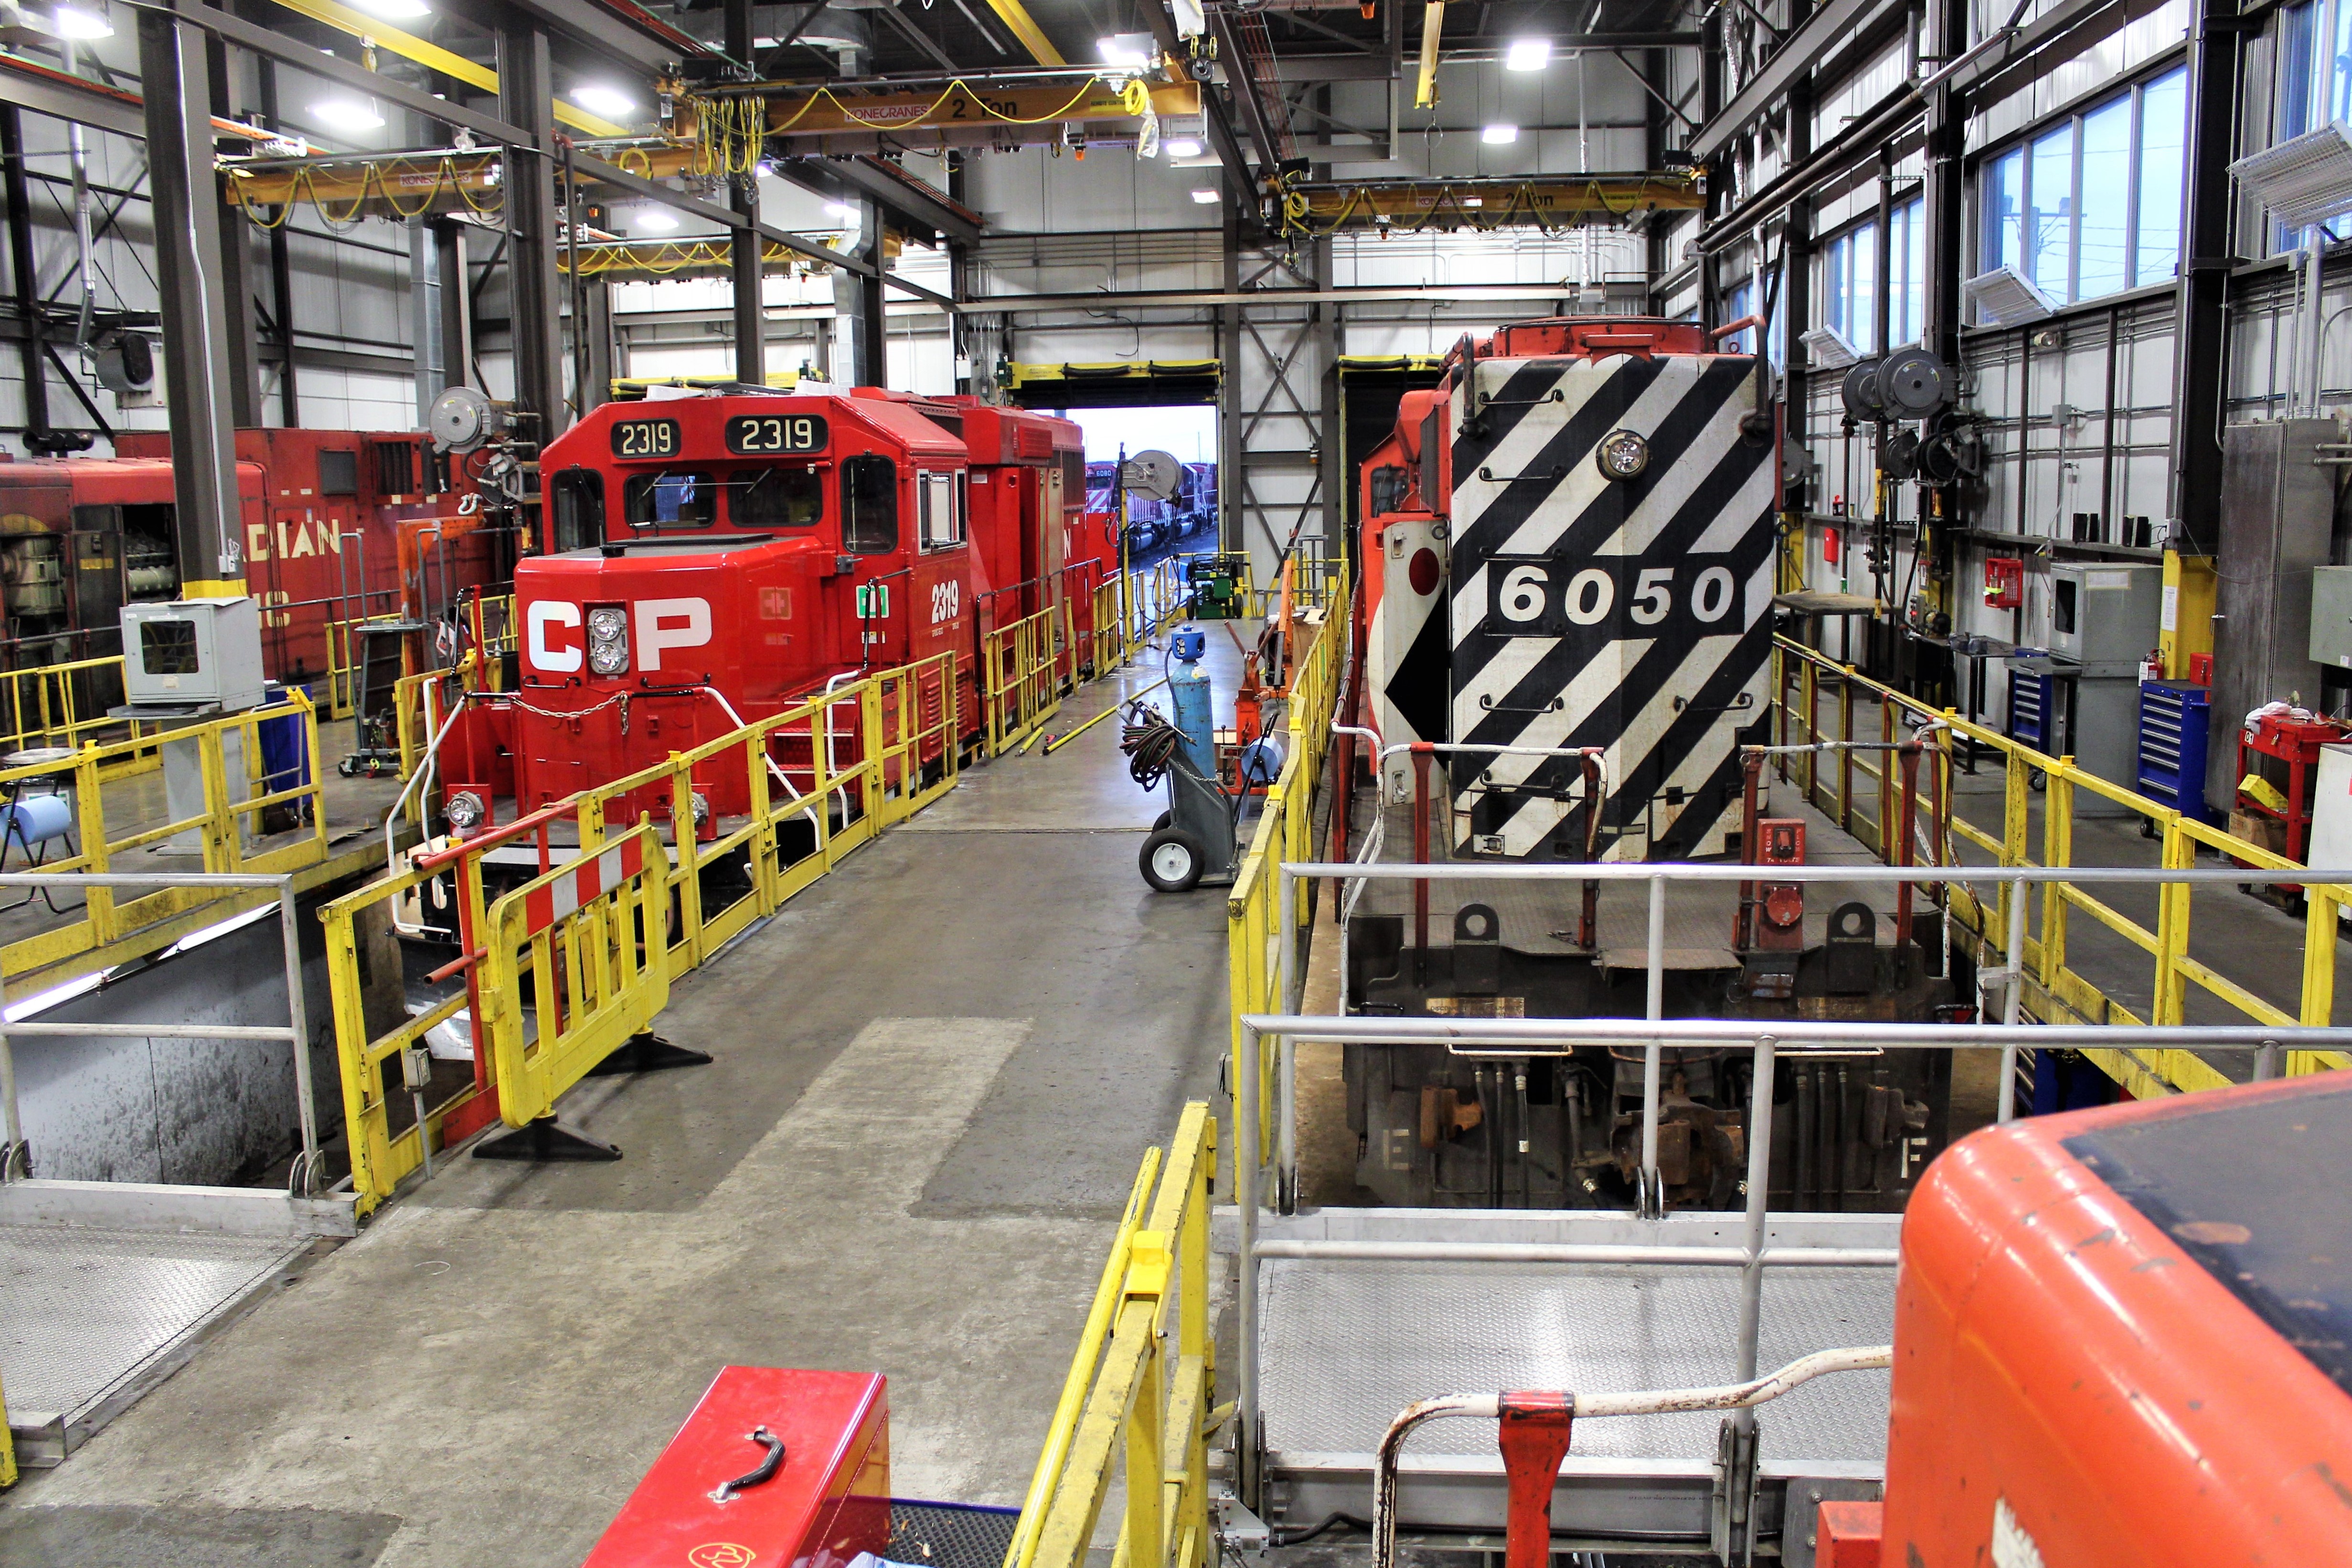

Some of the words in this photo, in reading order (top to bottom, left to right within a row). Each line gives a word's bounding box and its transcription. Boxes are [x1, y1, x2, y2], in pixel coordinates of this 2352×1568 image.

[847, 105, 928, 120] KONECRANES
[952, 98, 966, 118] 2
[980, 97, 1017, 117] Ton
[622, 423, 671, 454] 2319
[742, 419, 812, 450] 2319
[243, 519, 341, 563] DIAN
[932, 579, 959, 624] 2319
[1500, 565, 1734, 625] 6050
